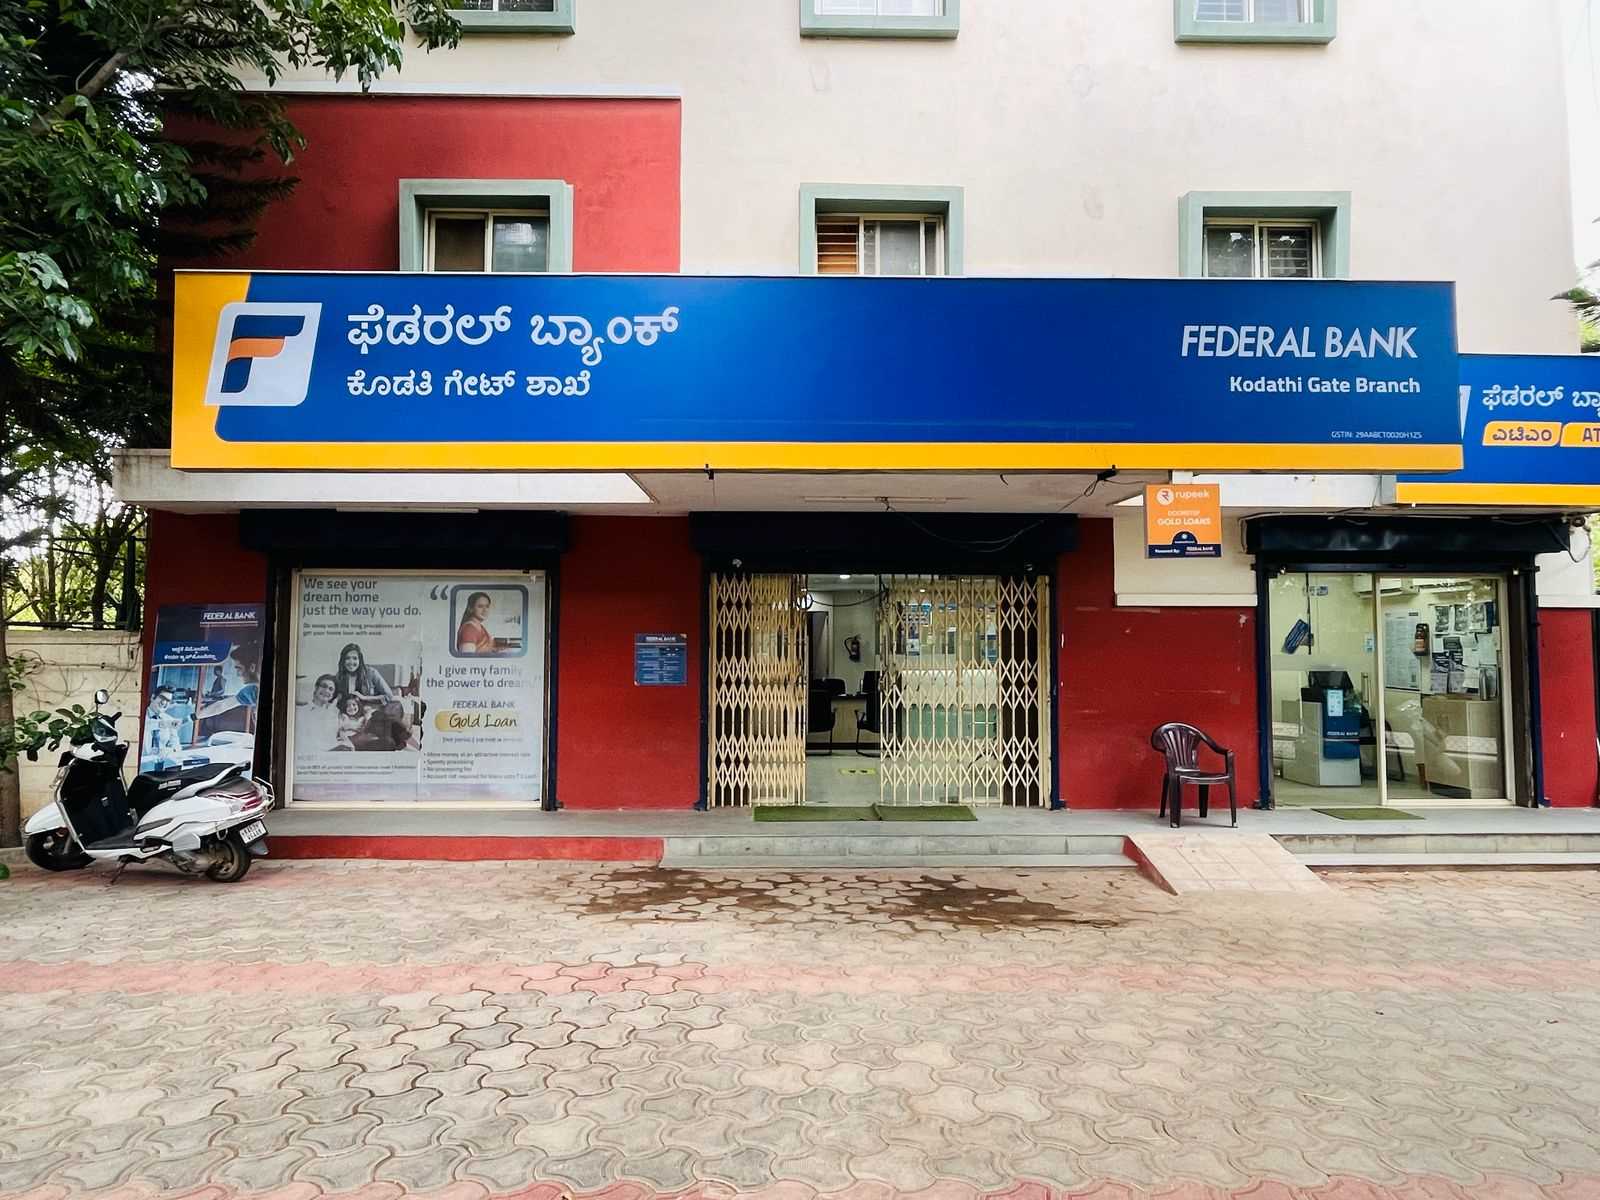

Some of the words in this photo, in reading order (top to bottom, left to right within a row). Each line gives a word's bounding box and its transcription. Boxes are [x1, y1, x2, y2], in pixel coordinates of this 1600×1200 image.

[348, 304, 512, 354] ಫೆಡರಲ್
[530, 306, 679, 366] ಬ್ಯಾಂಕ್
[1181, 325, 1316, 358] FEDERAL
[1325, 326, 1418, 358] BANK
[347, 369, 433, 396] ಕೊಡತಿ
[444, 369, 516, 396] ಗೇಟ್
[526, 370, 591, 396] ಶಾಖೆ
[1230, 376, 1302, 392] Kodathi
[1307, 376, 1350, 392] Gate
[1355, 376, 1420, 393] Branch
[1482, 385, 1564, 410] ಫೆಡರಲ್
[1492, 426, 1552, 441] ಎಟಿಎಂ
[1175, 489, 1210, 500] rupeek
[303, 577, 324, 589] We
[327, 580, 348, 589] see
[350, 580, 378, 592] your
[303, 592, 342, 602] dream
[345, 592, 379, 602] home
[203, 612, 233, 620] FEDERAL
[234, 611, 256, 619] BANK
[302, 604, 325, 618] just
[329, 604, 349, 616] the
[351, 607, 376, 618] way
[379, 607, 400, 618] you
[403, 605, 422, 616] do.
[445, 665, 467, 677] give
[469, 667, 487, 677] my
[426, 679, 445, 688] the
[447, 680, 481, 690] power
[483, 679, 495, 688] to
[452, 701, 488, 709] FEDERAL
[491, 701, 515, 709] BANK
[449, 713, 481, 729] Gold
[484, 714, 517, 728] Loan
